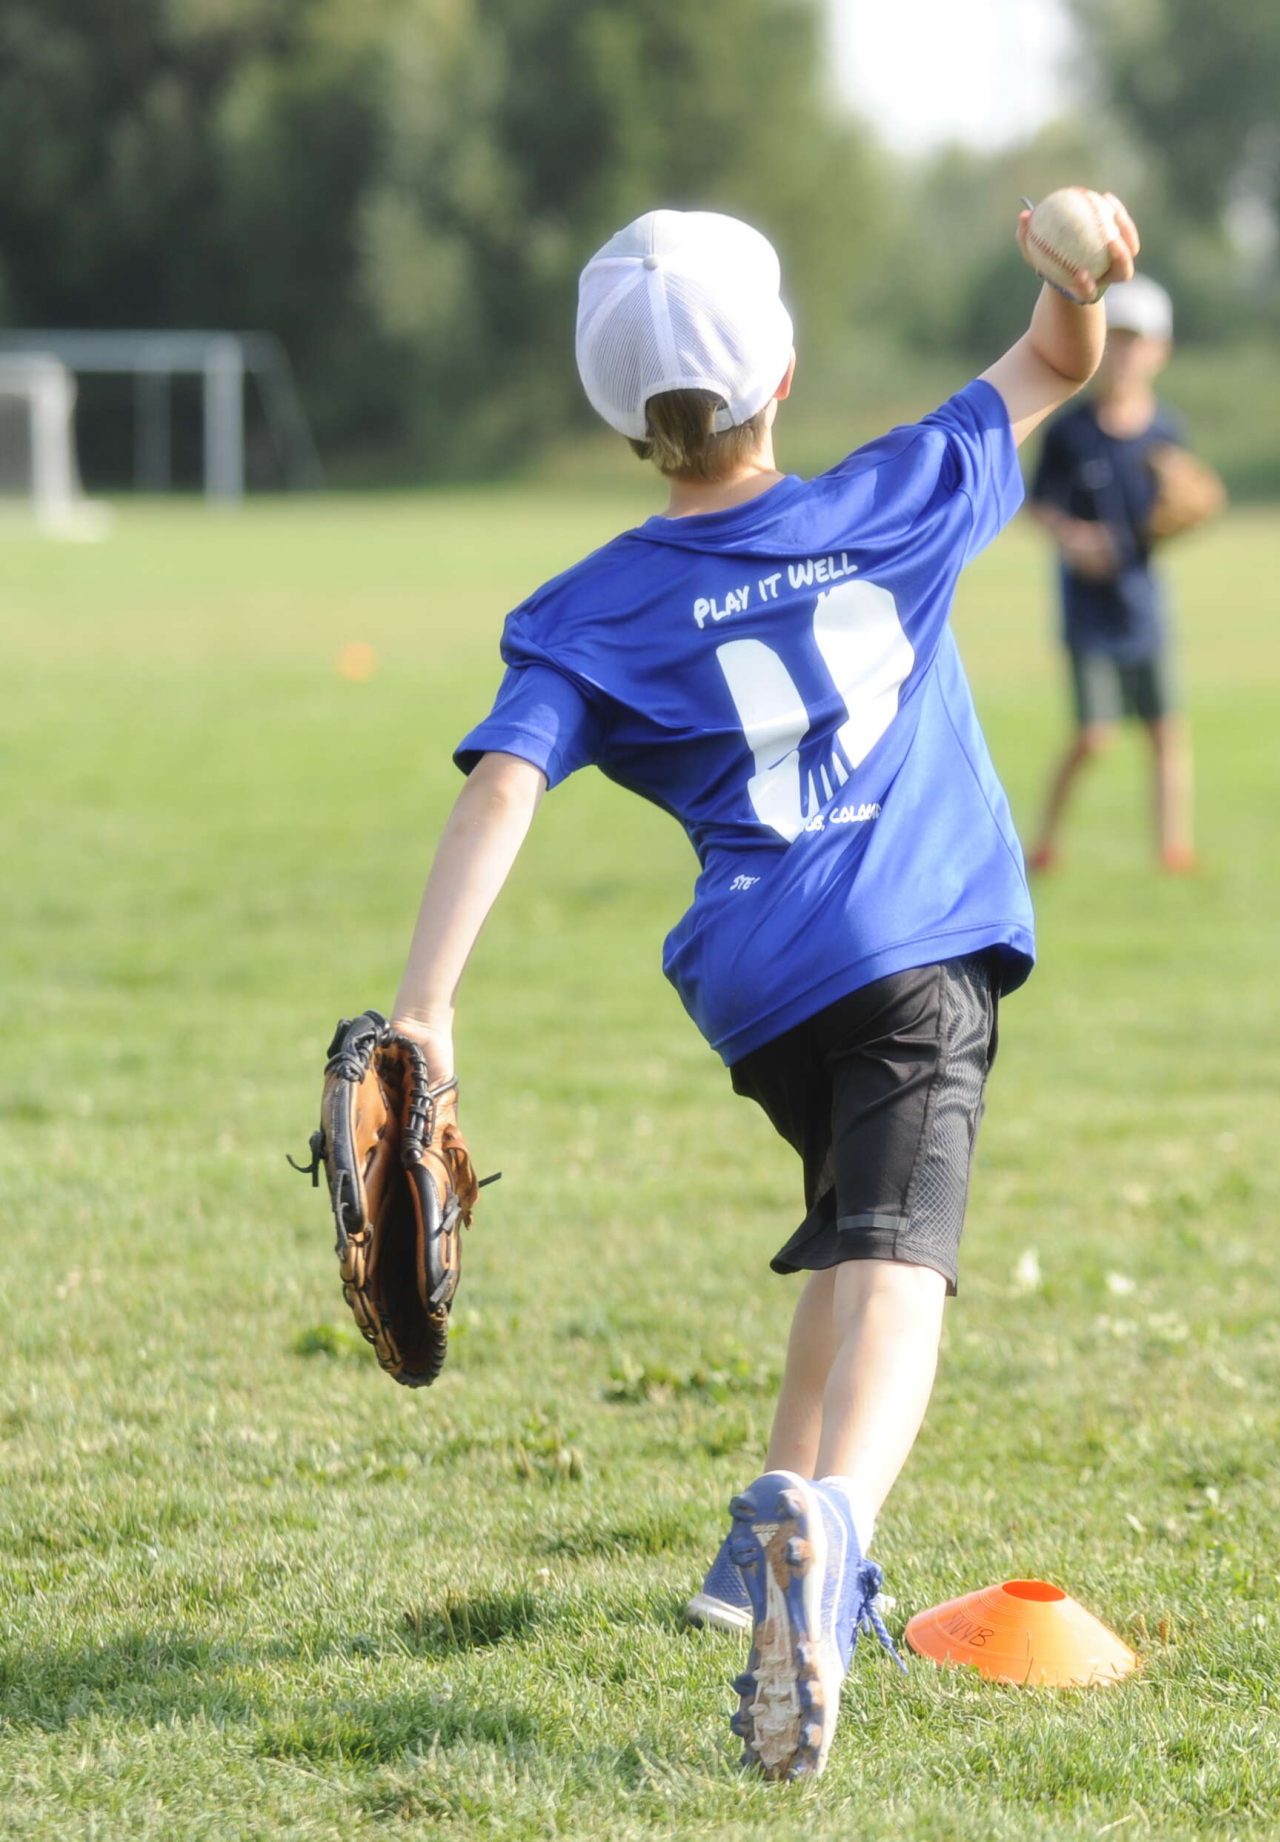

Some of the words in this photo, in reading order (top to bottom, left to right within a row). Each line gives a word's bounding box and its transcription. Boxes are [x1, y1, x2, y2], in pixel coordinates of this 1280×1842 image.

[693, 585, 750, 630] PLAY
[758, 572, 783, 602] IT
[787, 552, 859, 590] WELL
